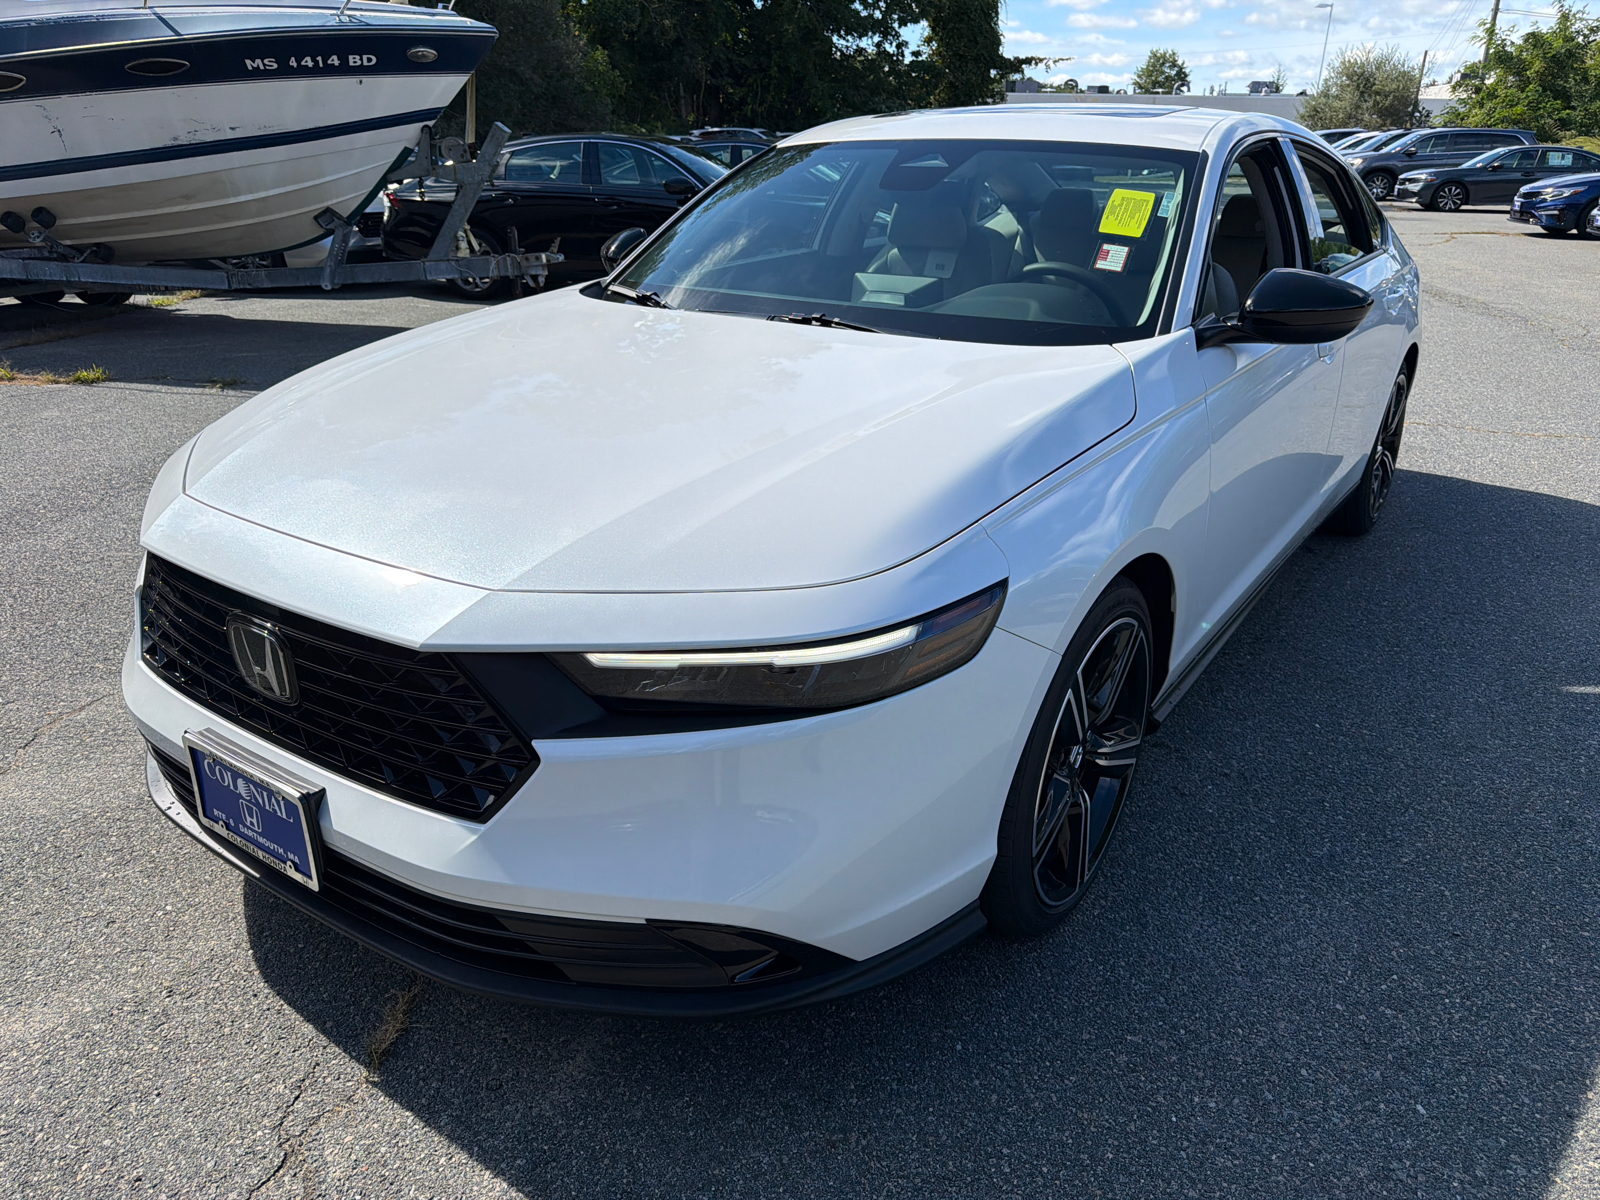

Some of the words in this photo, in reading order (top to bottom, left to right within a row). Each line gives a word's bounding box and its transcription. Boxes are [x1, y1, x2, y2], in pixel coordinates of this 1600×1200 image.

[244, 58, 278, 70] MS
[288, 54, 341, 68] 4414
[348, 54, 377, 66] BD
[204, 759, 293, 823] COLONIAL
[226, 832, 261, 858] COLONIAL
[261, 852, 289, 874] HONDA
[238, 823, 287, 859] DARTMOUTH,
[287, 850, 301, 865] MA
